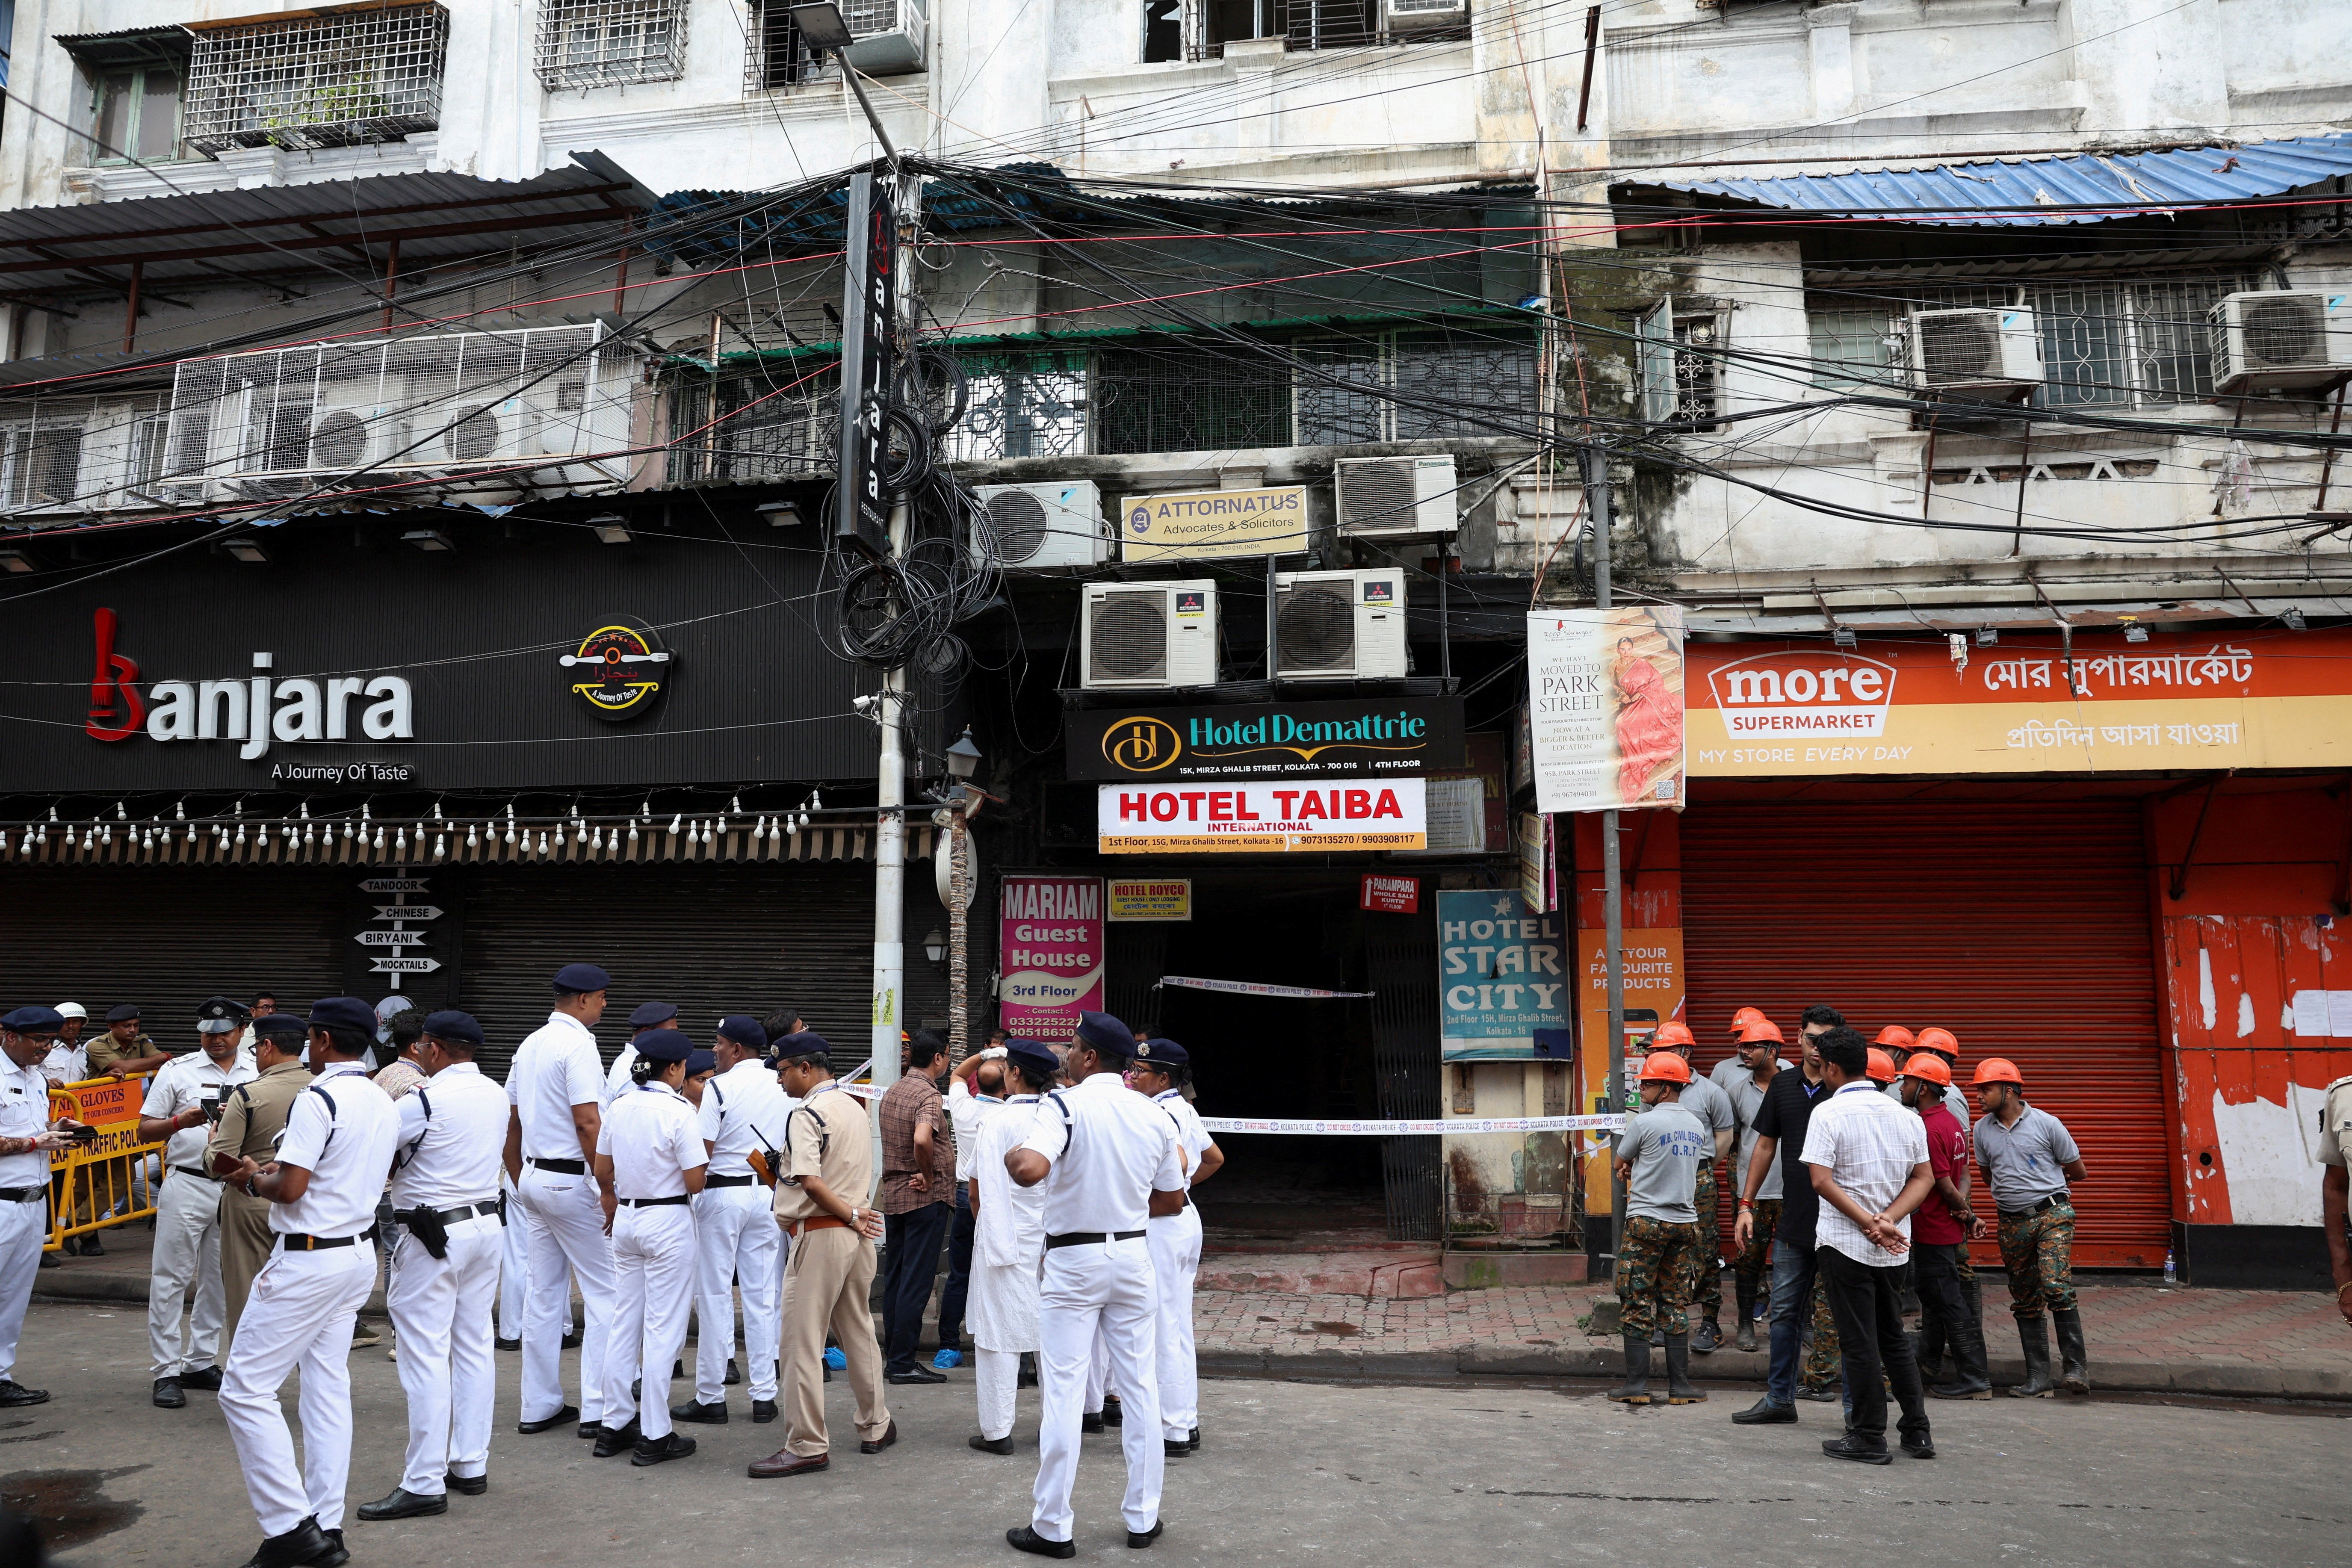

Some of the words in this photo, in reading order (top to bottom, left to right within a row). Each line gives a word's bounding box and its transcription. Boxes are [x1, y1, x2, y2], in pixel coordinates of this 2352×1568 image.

[1157, 493, 1299, 518] ATTORNATUS
[1163, 523, 1224, 534] Advocates
[1228, 521, 1236, 530] &
[1241, 518, 1294, 529] Solicitors
[1564, 629, 1593, 638] Shringar
[1540, 664, 1581, 675] MOVED
[1584, 663, 1600, 672] TO
[1984, 657, 2052, 690] মোর
[2060, 644, 2254, 698] সুপারমার্কেট
[86, 607, 414, 760] Banjara
[1542, 675, 1600, 695] PARK
[1726, 667, 1884, 703] more
[597, 691, 616, 703] Journey
[616, 692, 623, 701] Of
[623, 689, 638, 700] Taste
[1540, 695, 1604, 712] STREET
[1190, 716, 1266, 746] Hotel
[1273, 711, 1425, 742] Demattrie
[1733, 714, 1876, 730] SUPERMARKET
[2006, 718, 2095, 748] প্রতিদিন
[2101, 723, 2160, 746] আসা
[2166, 721, 2239, 745] যাওয়া
[1553, 743, 1592, 751] LOCATION
[1699, 749, 1727, 763] MY
[1733, 748, 1795, 763] STORE
[1805, 747, 1869, 762] EVERY
[1874, 746, 1913, 760] DAY
[272, 764, 282, 778] A
[286, 764, 344, 783] Journey
[348, 764, 366, 780] Of
[370, 765, 408, 780] Taste
[1253, 765, 1284, 773] STREET,
[1120, 792, 1259, 822] HOTEL
[1273, 789, 1404, 820] TAIBA
[1208, 822, 1313, 832] INTERNATIONAL
[1125, 837, 1150, 847] Floor,
[1301, 835, 1354, 844] 9073135270
[1362, 835, 1415, 843] 9903908117
[367, 881, 417, 890] TANDOOR
[1115, 885, 1146, 896] HOTEL
[1149, 885, 1184, 895] ROYCO
[1374, 877, 1414, 893] PARAMPARA
[1005, 884, 1097, 920] MARIAM
[386, 908, 429, 917] CHINESE
[365, 933, 413, 943] BIRYANI
[1015, 924, 1088, 942] Guest
[1444, 919, 1559, 943] HOTEL
[1012, 949, 1090, 967] House
[1445, 945, 1561, 976] STAR
[1626, 948, 1667, 958] YOUR
[380, 960, 428, 969] MOCKTAILS
[1590, 963, 1672, 974] FAOURITE
[1013, 985, 1036, 996] 3rd
[1041, 986, 1077, 996] Floor
[1447, 983, 1562, 1011] CITY
[1447, 1015, 1459, 1024] 2nd
[1482, 1014, 1496, 1024] 15H,
[1498, 1014, 1516, 1022] Mirza
[1518, 1013, 1539, 1022] Ghalib
[1541, 1013, 1564, 1024] Street,
[1009, 1028, 1075, 1036] 90518630
[1486, 1027, 1512, 1035] Kolkata
[1518, 1026, 1526, 1035] 16
[81, 1088, 124, 1107] GLOVES
[90, 1110, 100, 1118] OUR
[102, 1106, 124, 1115] CONCERN
[1660, 1133, 1672, 1147] W.B.
[1674, 1131, 1687, 1141] CIVIL
[1688, 1131, 1703, 1148] DEFEN
[1672, 1144, 1696, 1157] Q.R.T
